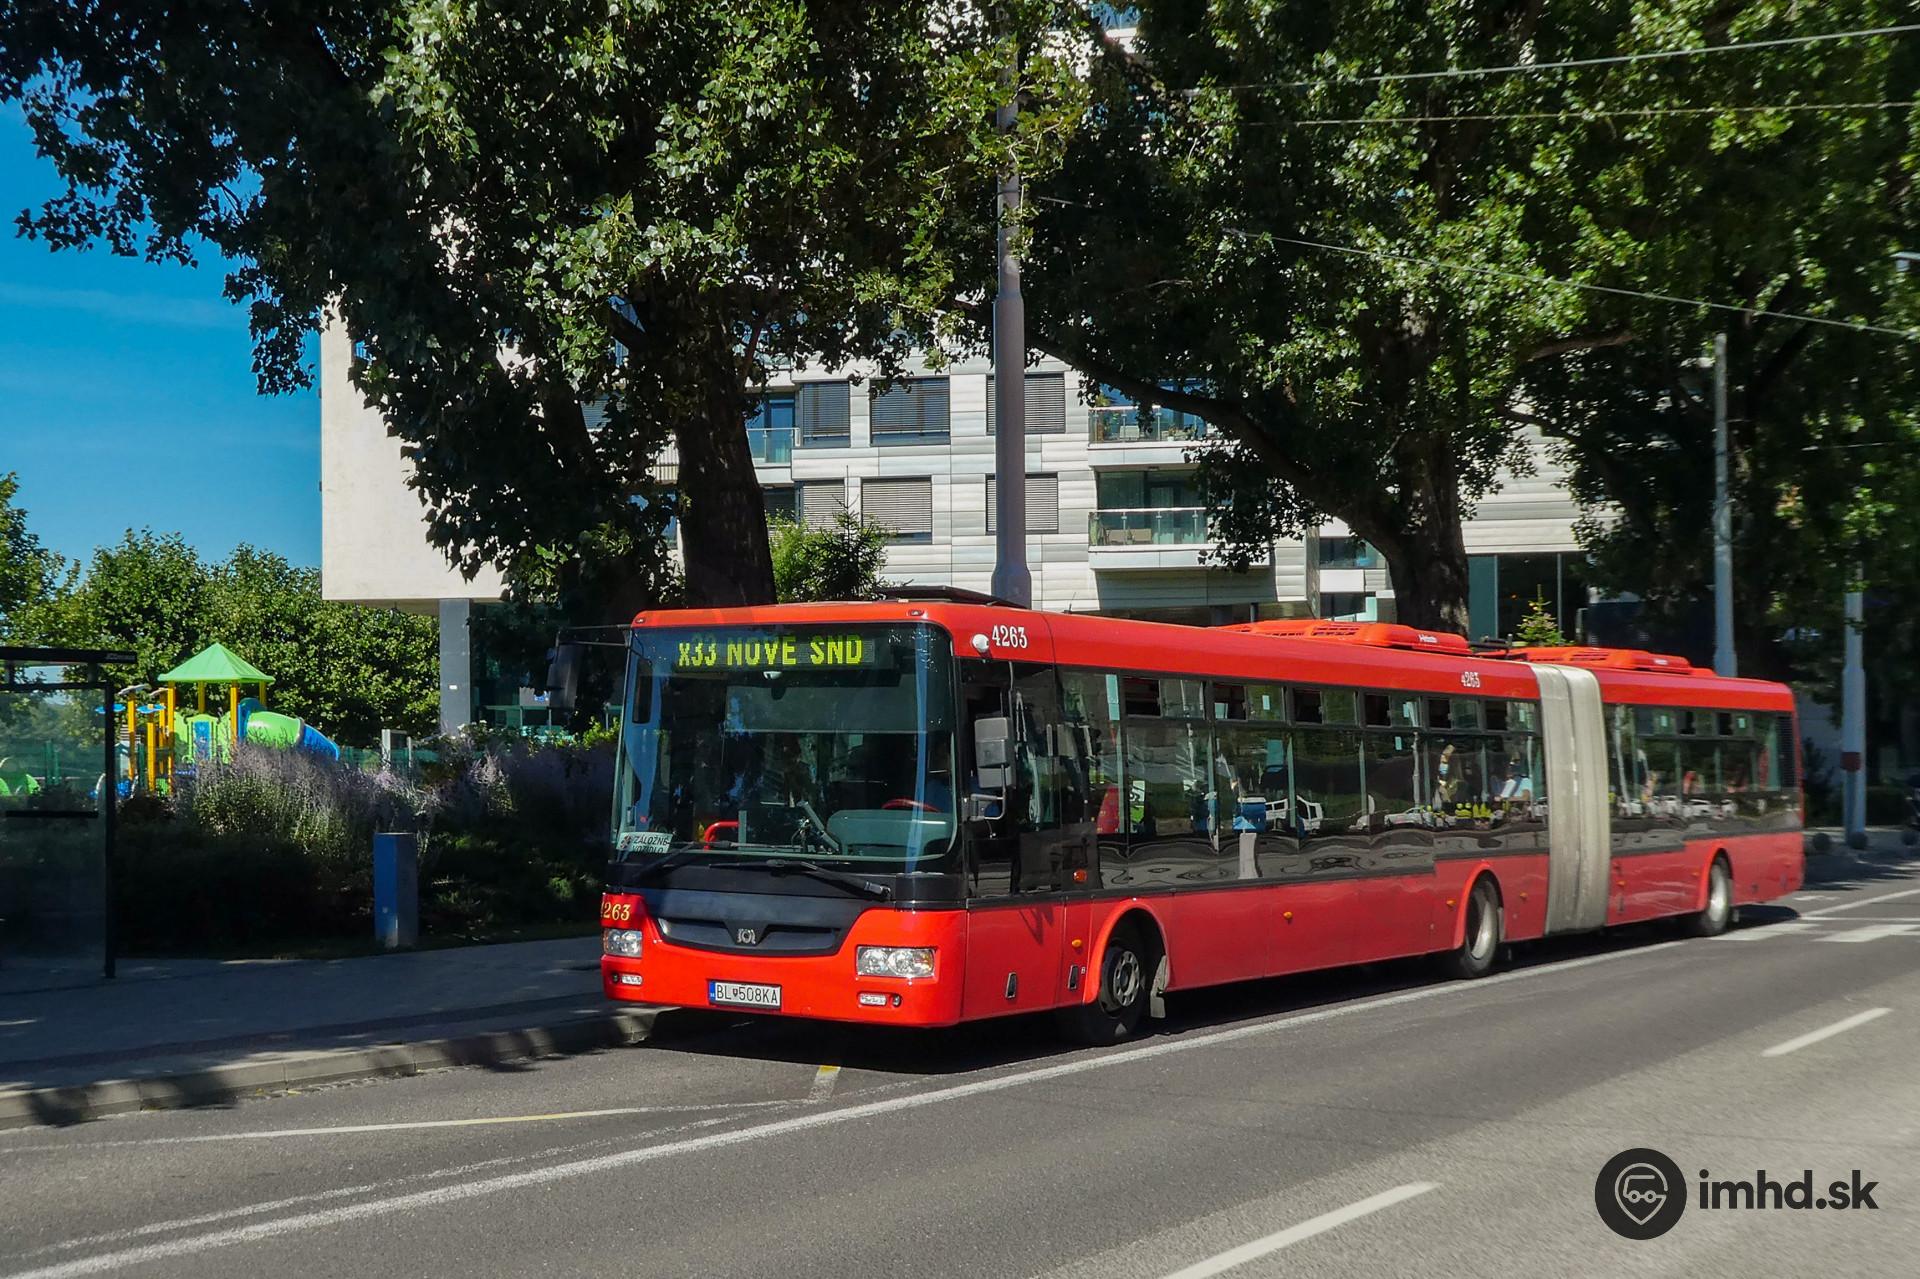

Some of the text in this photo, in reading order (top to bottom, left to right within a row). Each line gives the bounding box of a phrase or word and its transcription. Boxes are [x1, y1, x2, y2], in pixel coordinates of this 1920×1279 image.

[992, 624, 1028, 649] 4263
[678, 636, 717, 667] X33
[809, 635, 863, 665] SND
